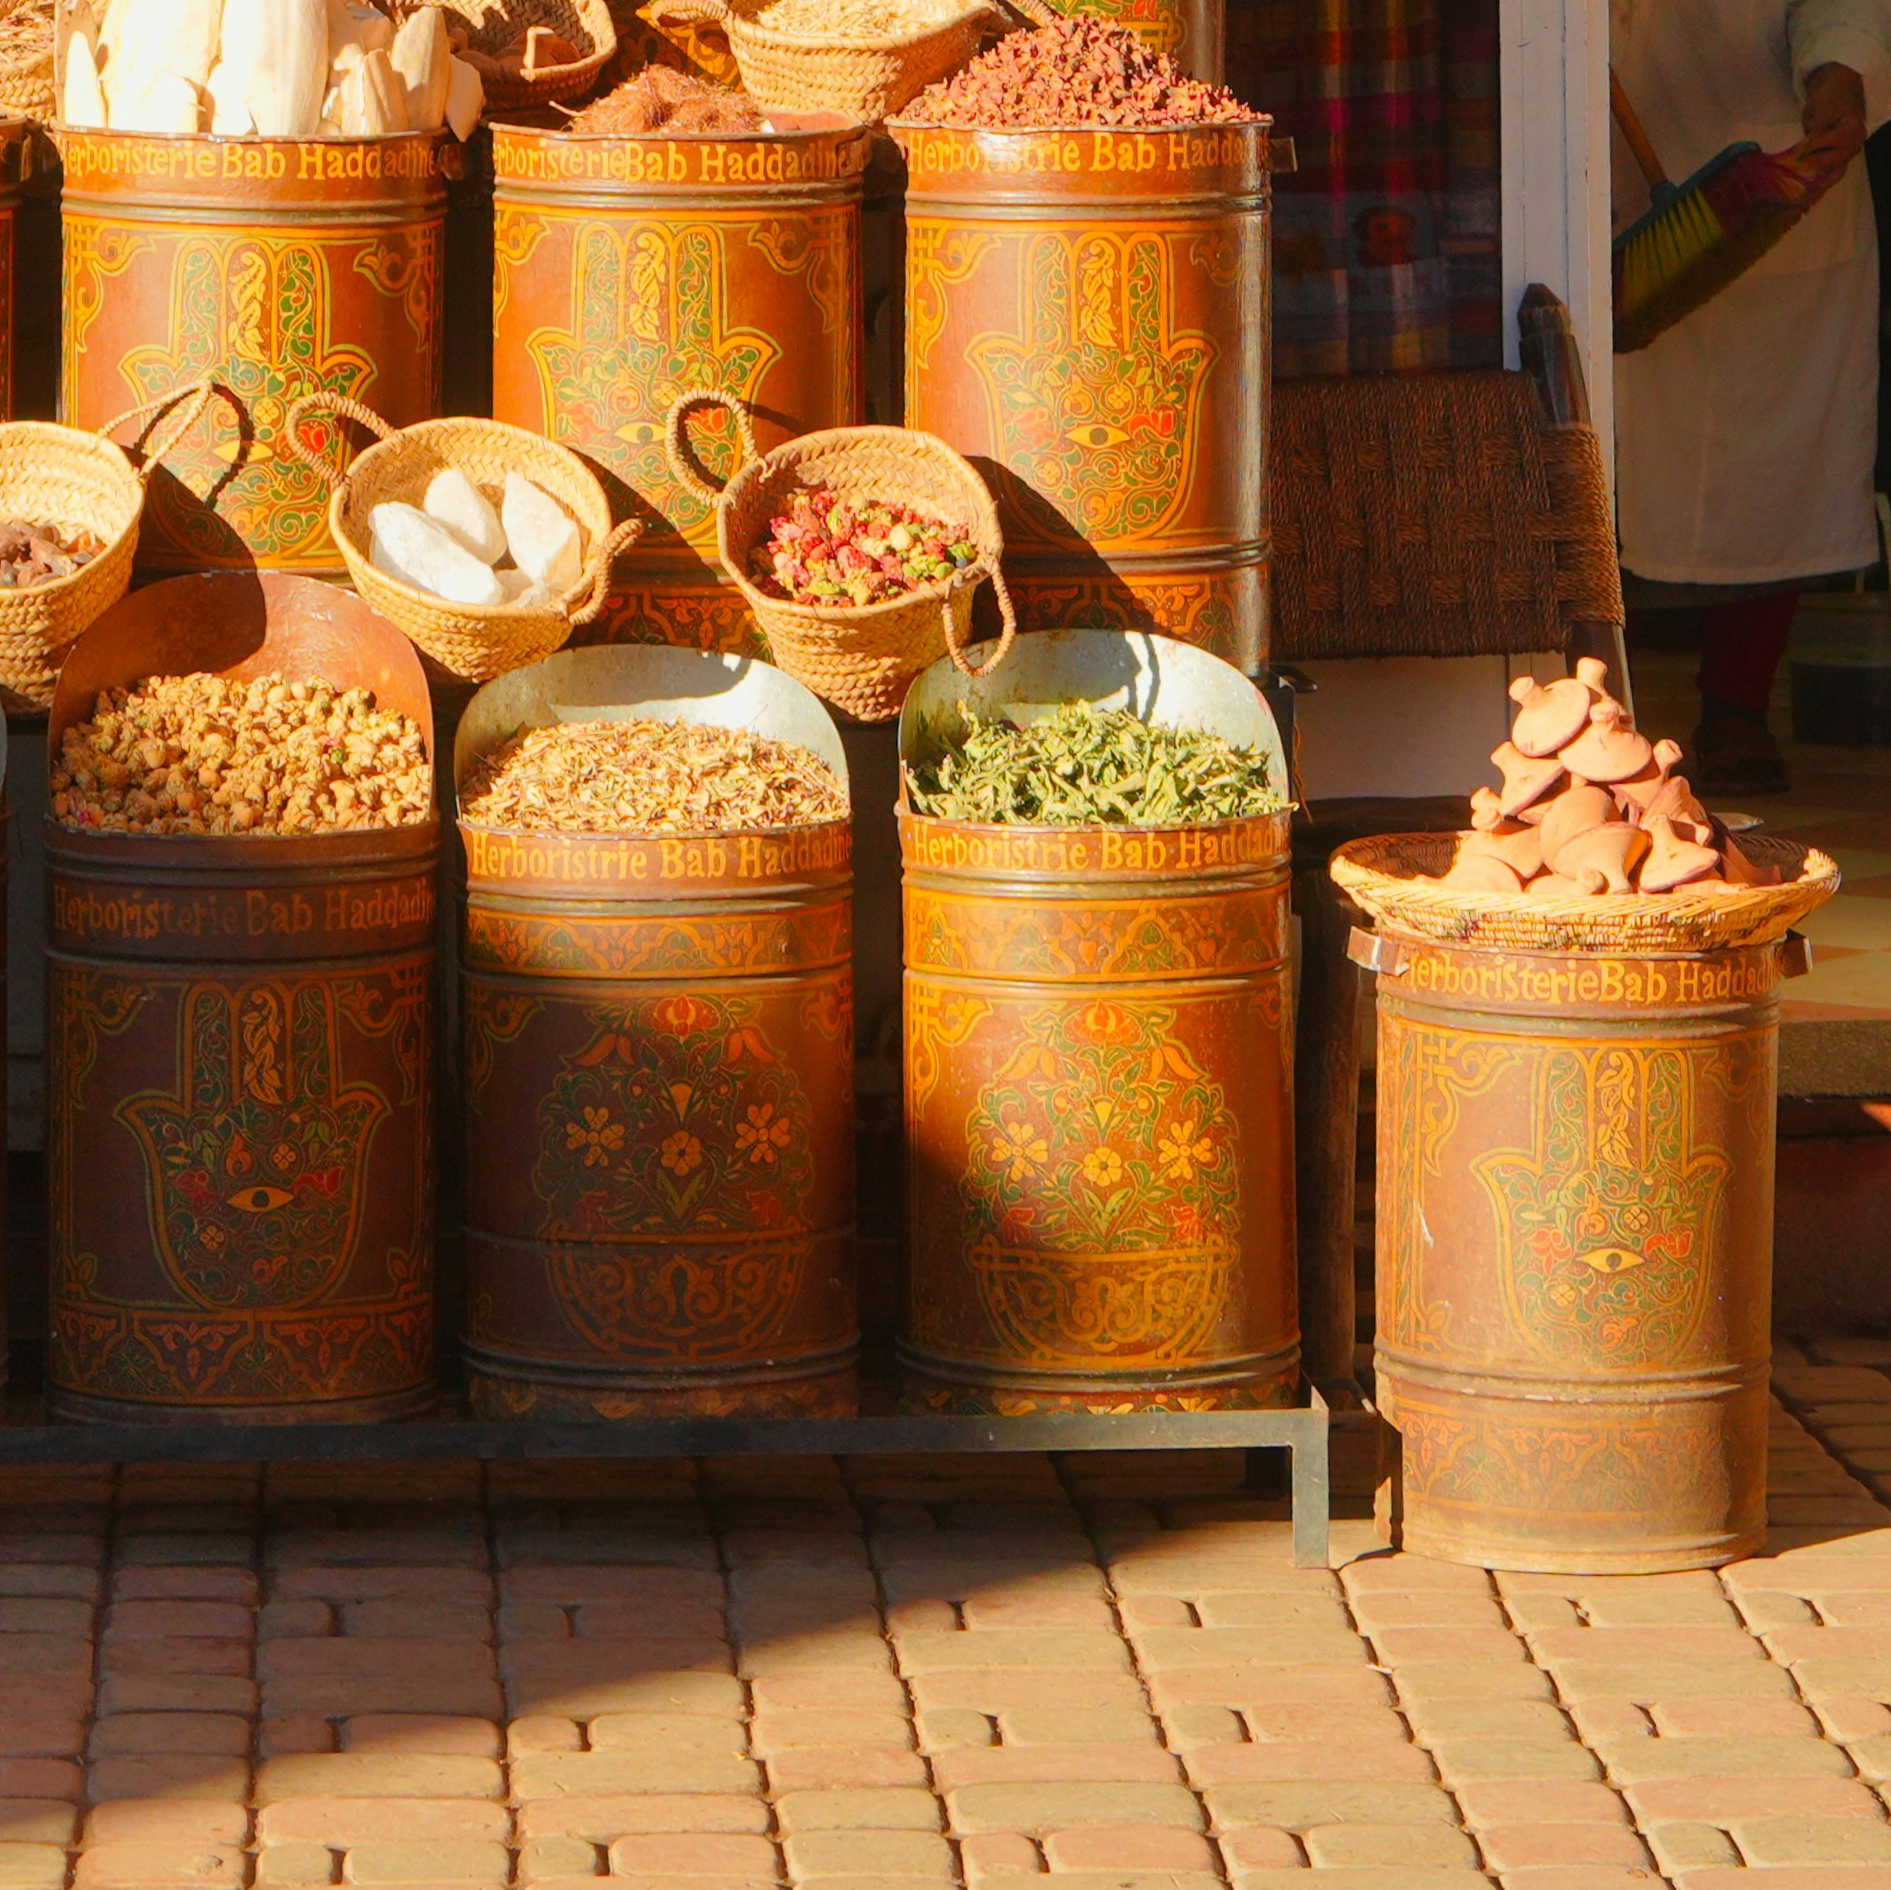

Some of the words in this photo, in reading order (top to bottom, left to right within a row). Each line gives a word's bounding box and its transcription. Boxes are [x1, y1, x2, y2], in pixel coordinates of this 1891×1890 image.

[221, 142, 287, 179] Bab
[296, 139, 436, 181] Haddadine
[624, 141, 688, 183] Bab
[1088, 132, 1157, 173] Bab
[471, 830, 648, 881] Herboristrie
[659, 837, 726, 881] Bab
[913, 823, 1088, 871] Herboristrie
[1101, 830, 1167, 871] Bab
[245, 889, 313, 936] Bab
[1598, 959, 1667, 1005] Bab
